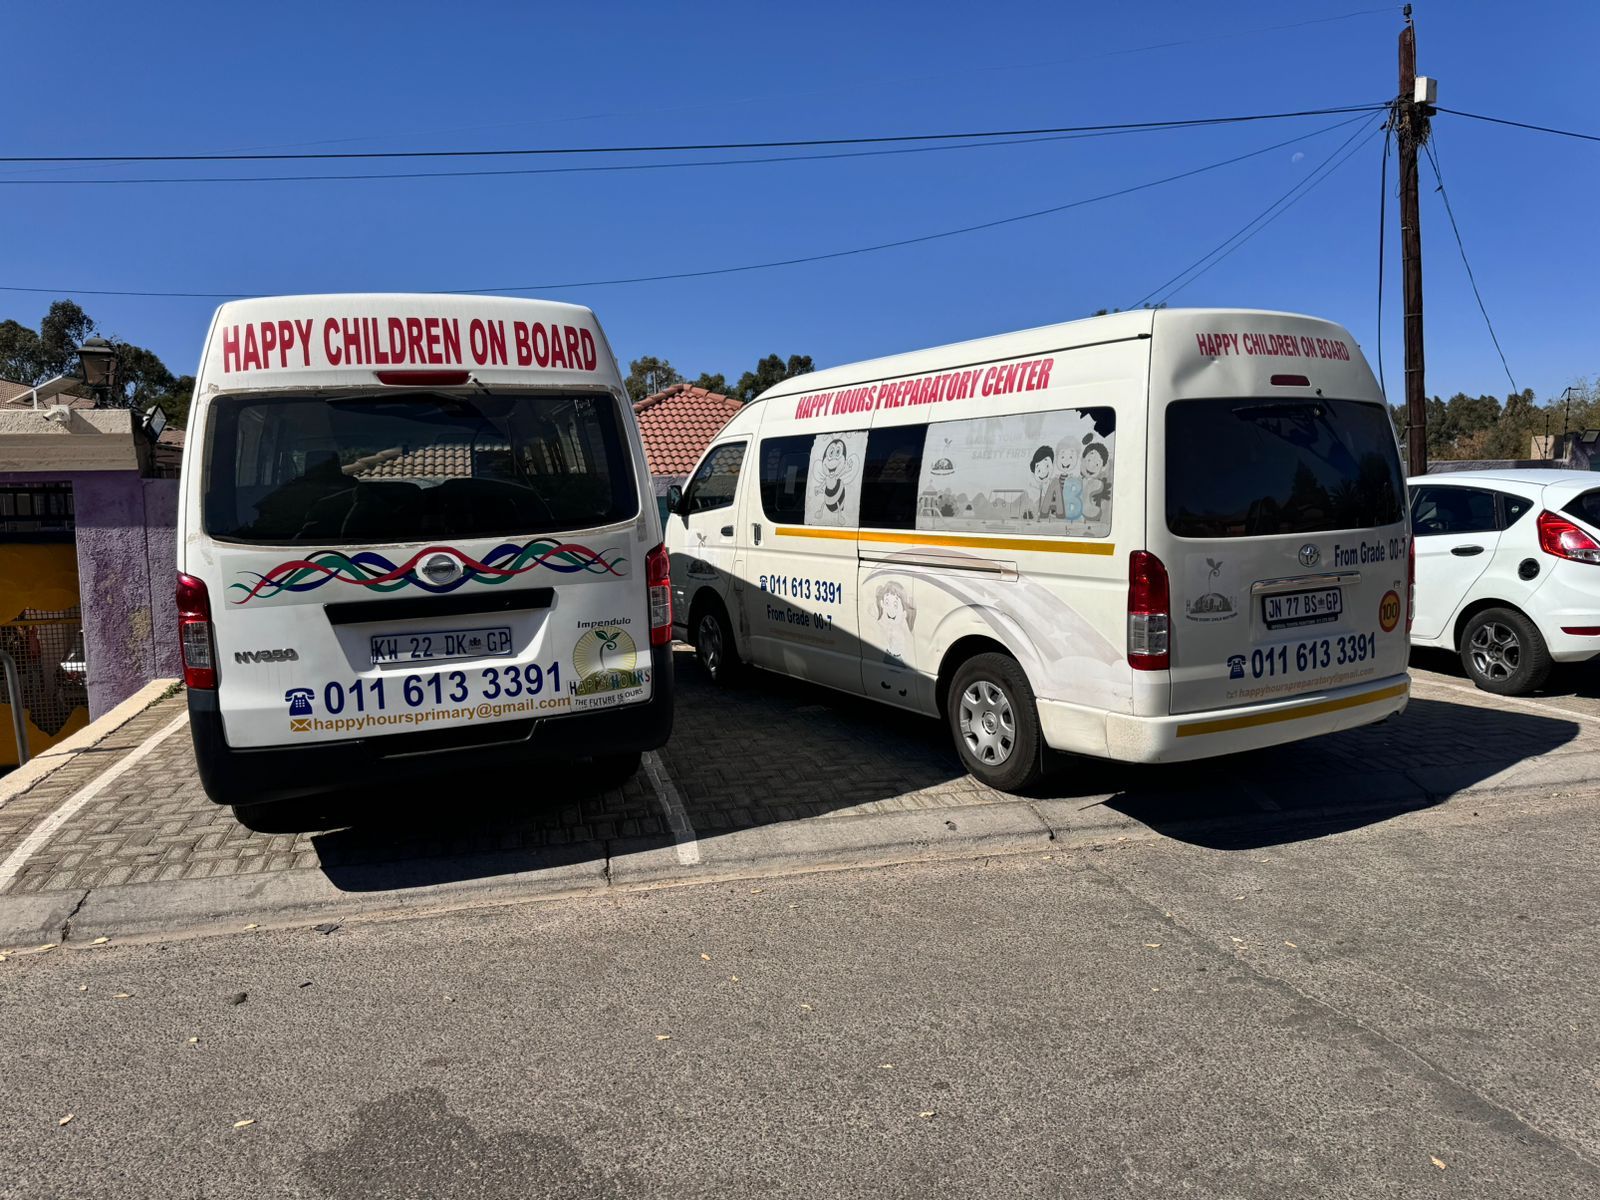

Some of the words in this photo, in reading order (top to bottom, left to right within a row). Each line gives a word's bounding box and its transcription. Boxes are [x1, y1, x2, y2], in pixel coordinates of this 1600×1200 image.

[223, 318, 314, 373] HAPPY
[323, 317, 462, 366] CHILDREN
[469, 318, 508, 366] ON
[514, 321, 597, 371] BOARD
[1196, 333, 1240, 356] HAPPY
[1243, 333, 1301, 357] CHILDREN
[1301, 336, 1318, 358] ON
[1316, 338, 1350, 361] BOARD
[795, 392, 834, 420] HAPPY
[831, 385, 878, 415] HOURS
[875, 368, 984, 410] PREPARATORY
[982, 358, 1054, 397] CENTER
[1334, 545, 1358, 567] From
[1360, 541, 1385, 564] Grade
[770, 575, 788, 596] 011
[791, 577, 811, 600] 613
[814, 580, 842, 604] 3391
[767, 604, 786, 623] From
[787, 608, 810, 628] Grade
[813, 613, 832, 631] 00-7
[1269, 599, 1281, 618] JN
[1286, 597, 1299, 616] 77
[1304, 595, 1317, 614] BS
[1326, 592, 1338, 611] GP
[1382, 601, 1398, 620] 100
[577, 617, 631, 629] Impendulo
[234, 648, 299, 664] NV350
[374, 639, 398, 660] KW
[410, 637, 433, 658] 22
[445, 634, 467, 655] DK
[487, 631, 510, 652] GP
[1251, 645, 1288, 678] 011
[1296, 639, 1331, 672] 613
[1336, 632, 1376, 666] 3391
[324, 677, 385, 715] 011
[403, 670, 468, 707] 613
[481, 661, 561, 699] 3391
[569, 674, 609, 696] HAPPY
[610, 669, 651, 689] HOURS
[575, 698, 588, 706] THE
[589, 695, 616, 707] FUTURE
[624, 688, 643, 698] OURS
[314, 695, 571, 731] happyhoursprimary@gmail.com
